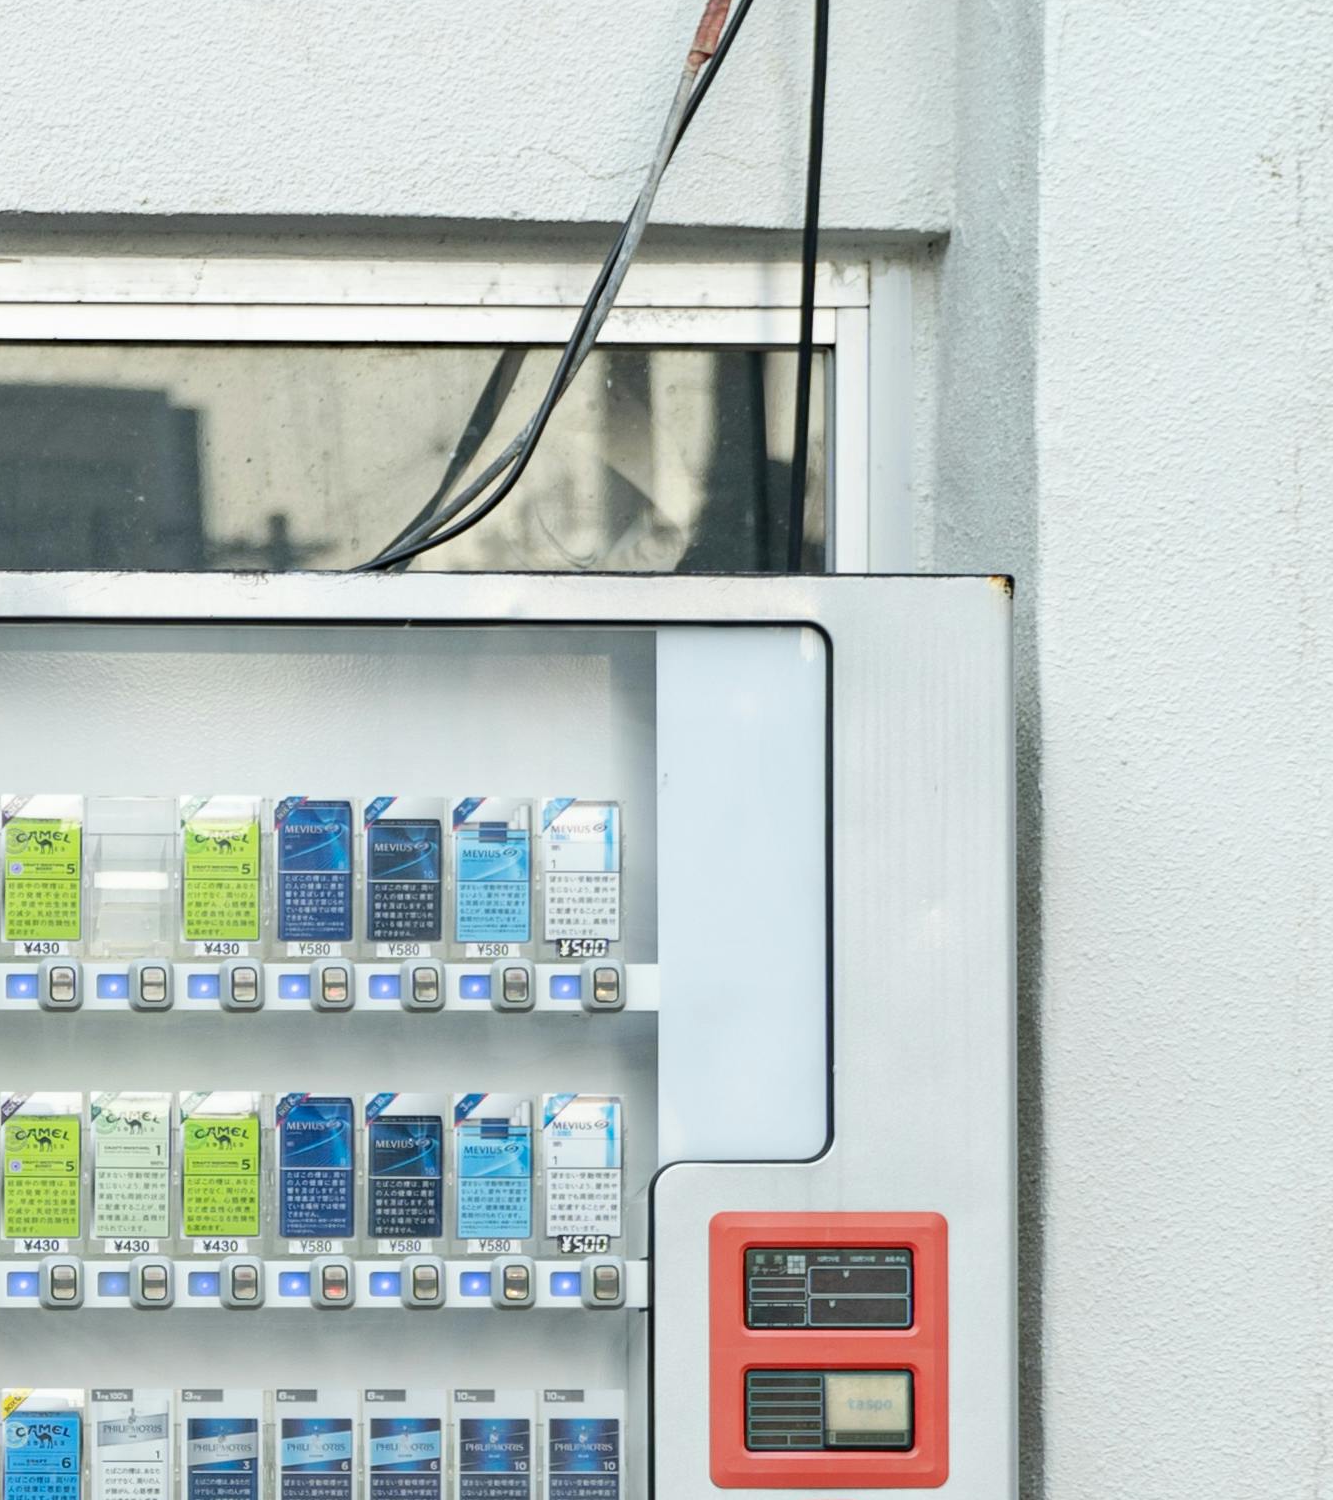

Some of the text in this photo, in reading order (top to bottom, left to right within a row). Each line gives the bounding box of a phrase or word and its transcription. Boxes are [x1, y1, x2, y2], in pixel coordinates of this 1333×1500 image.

[285, 825, 323, 834] MEVIUS
[15, 831, 71, 844] CAMEL
[374, 842, 414, 853] MEVIUS
[299, 944, 331, 956] ¥580
[477, 944, 509, 956] ¥580
[113, 1240, 151, 1252] ¥430
[389, 1240, 421, 1252] ¥580
[847, 1397, 893, 1412] taspo
[61, 1457, 71, 1468] 6
